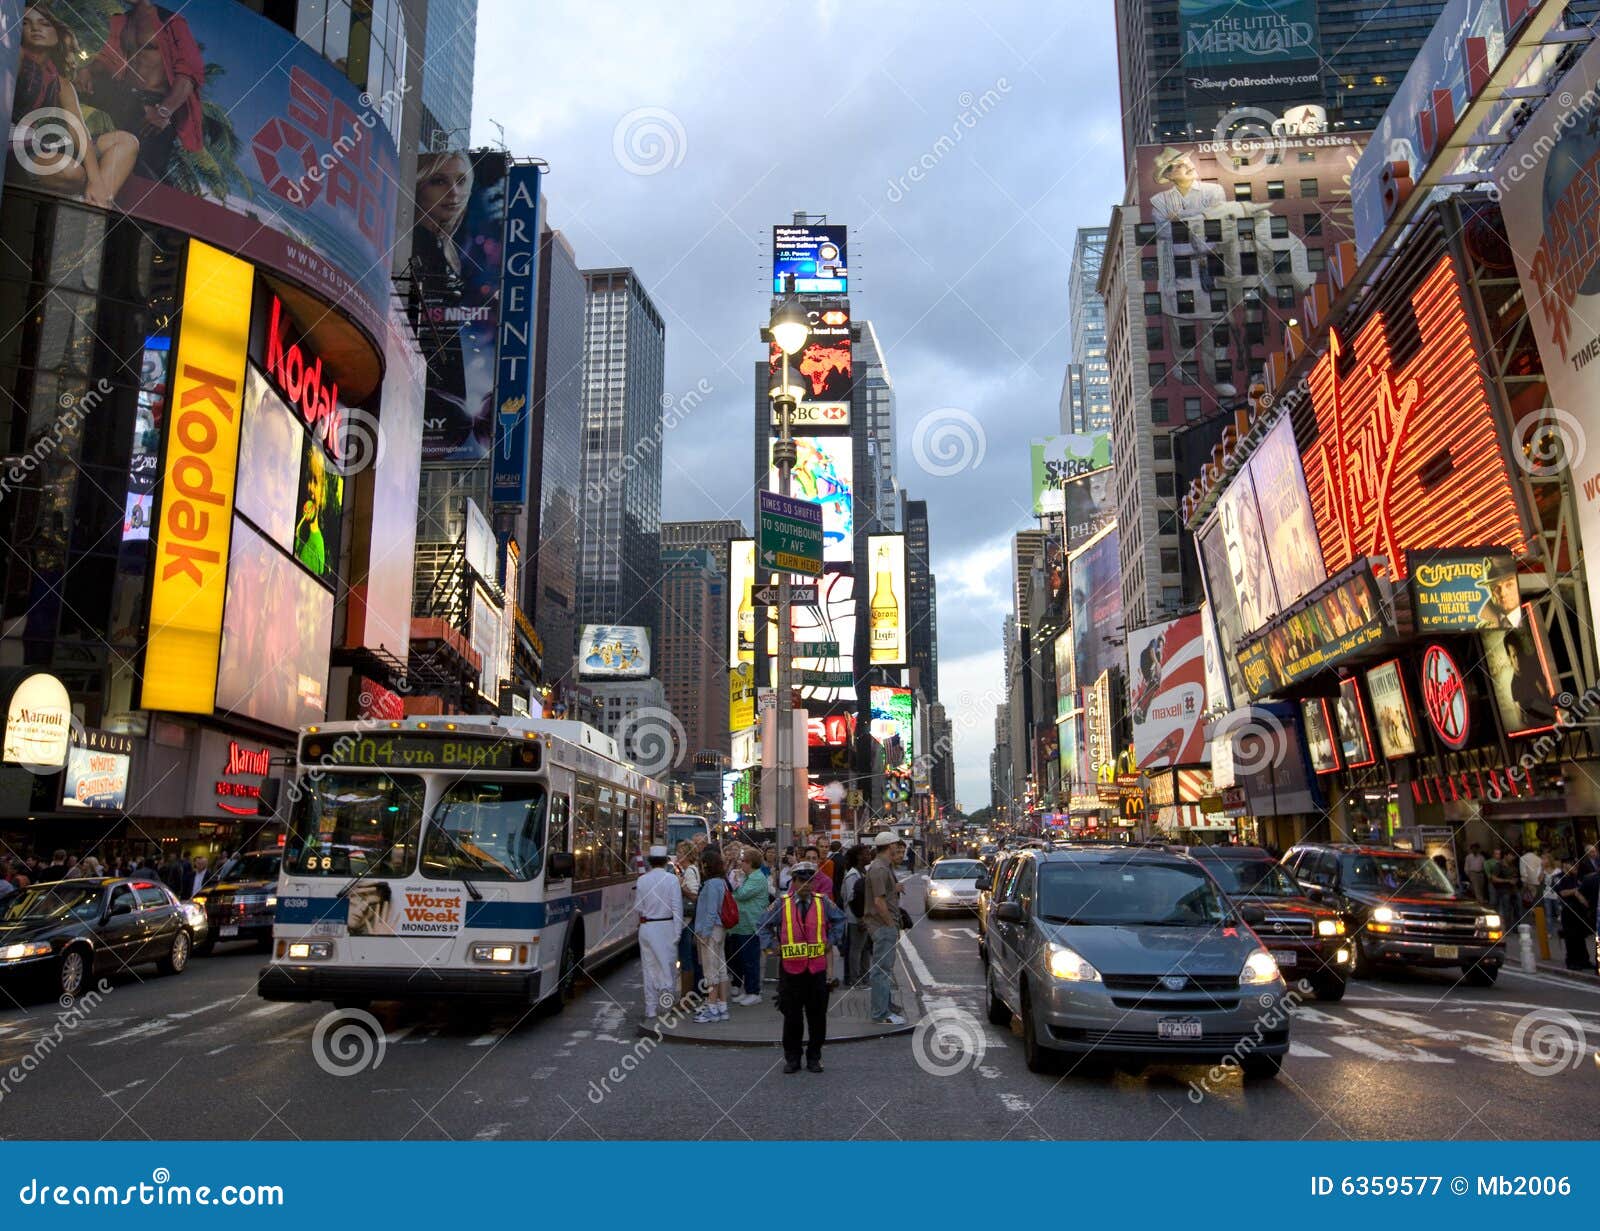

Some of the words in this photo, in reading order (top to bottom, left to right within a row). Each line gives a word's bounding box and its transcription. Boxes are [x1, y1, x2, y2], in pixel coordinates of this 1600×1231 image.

[1212, 17, 1240, 32] THE
[1244, 14, 1289, 30] LITTLE
[1185, 22, 1314, 55] MERMAID
[1184, 73, 1318, 91] DisneyOnBroadway.com
[1198, 142, 1229, 153] 100%
[1232, 138, 1303, 152] Colombian
[1307, 136, 1352, 148] Coffee
[500, 180, 535, 381] ARGENT
[444, 306, 491, 321] NIGHT
[266, 296, 343, 460] Kodak
[162, 363, 237, 588] Kodak
[1044, 458, 1095, 480] SHREK
[763, 497, 781, 512] TIMES
[783, 503, 792, 515] SQ
[794, 505, 821, 522] SHUFFLE
[762, 518, 772, 530] TO
[774, 522, 822, 542] SOUTHBOUND
[781, 538, 786, 547] 7
[790, 541, 805, 553] AVE
[777, 554, 799, 568] TURN
[800, 559, 821, 572] HERE
[762, 591, 780, 600] ONE
[871, 609, 897, 620] Corona
[805, 645, 813, 656] W
[816, 644, 828, 656] 45
[16, 708, 63, 726] Marriott
[1152, 703, 1182, 720] maxell
[71, 729, 132, 752] MARQUIS
[1087, 692, 1100, 773] PALACE
[224, 741, 269, 776] Marriott
[404, 750, 435, 762] VIA
[442, 744, 501, 765] BWAY
[90, 756, 116, 772] WHITE
[76, 777, 123, 801] CHRISTMAS
[284, 899, 309, 908] 6396
[405, 893, 461, 908] Worst
[404, 908, 459, 922] Week
[402, 924, 448, 932] MONDAYS
